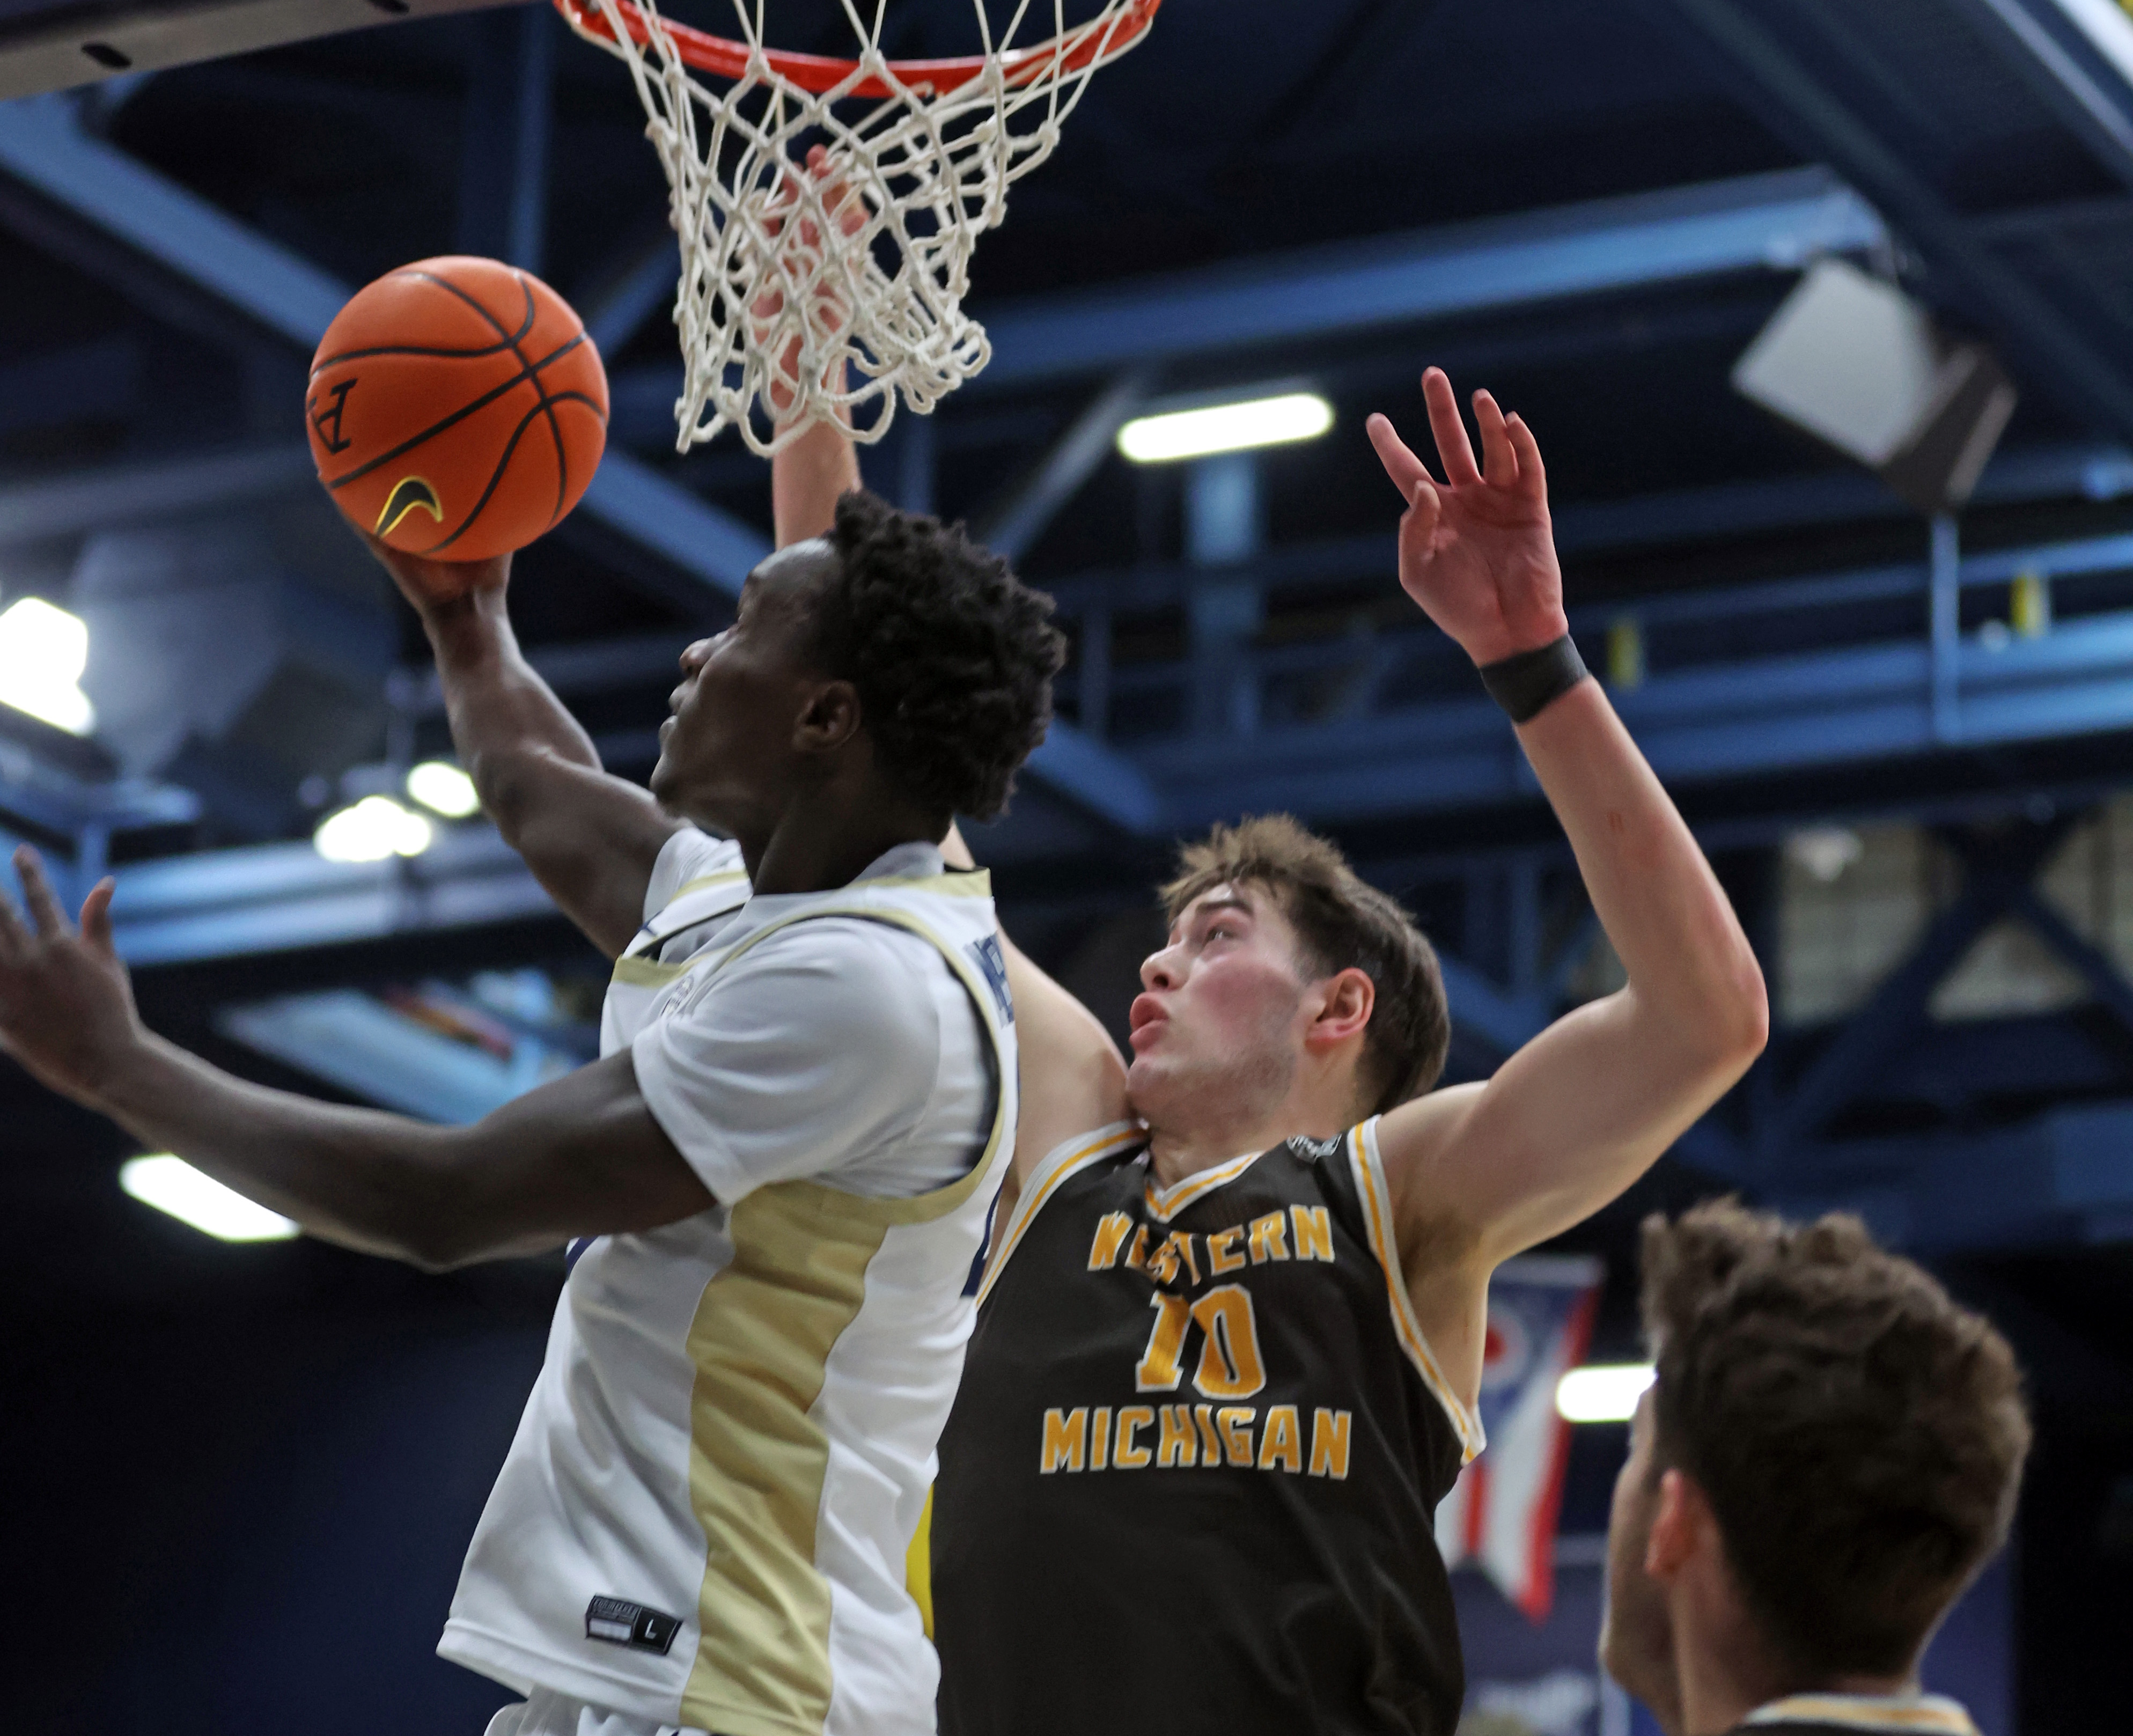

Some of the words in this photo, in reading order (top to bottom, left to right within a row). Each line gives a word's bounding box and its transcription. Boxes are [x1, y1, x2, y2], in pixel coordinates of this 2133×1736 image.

[1135, 1283, 1267, 1401] 10
[1040, 1403, 1352, 1480] MICHIGAN
[645, 1619, 657, 1639] L
